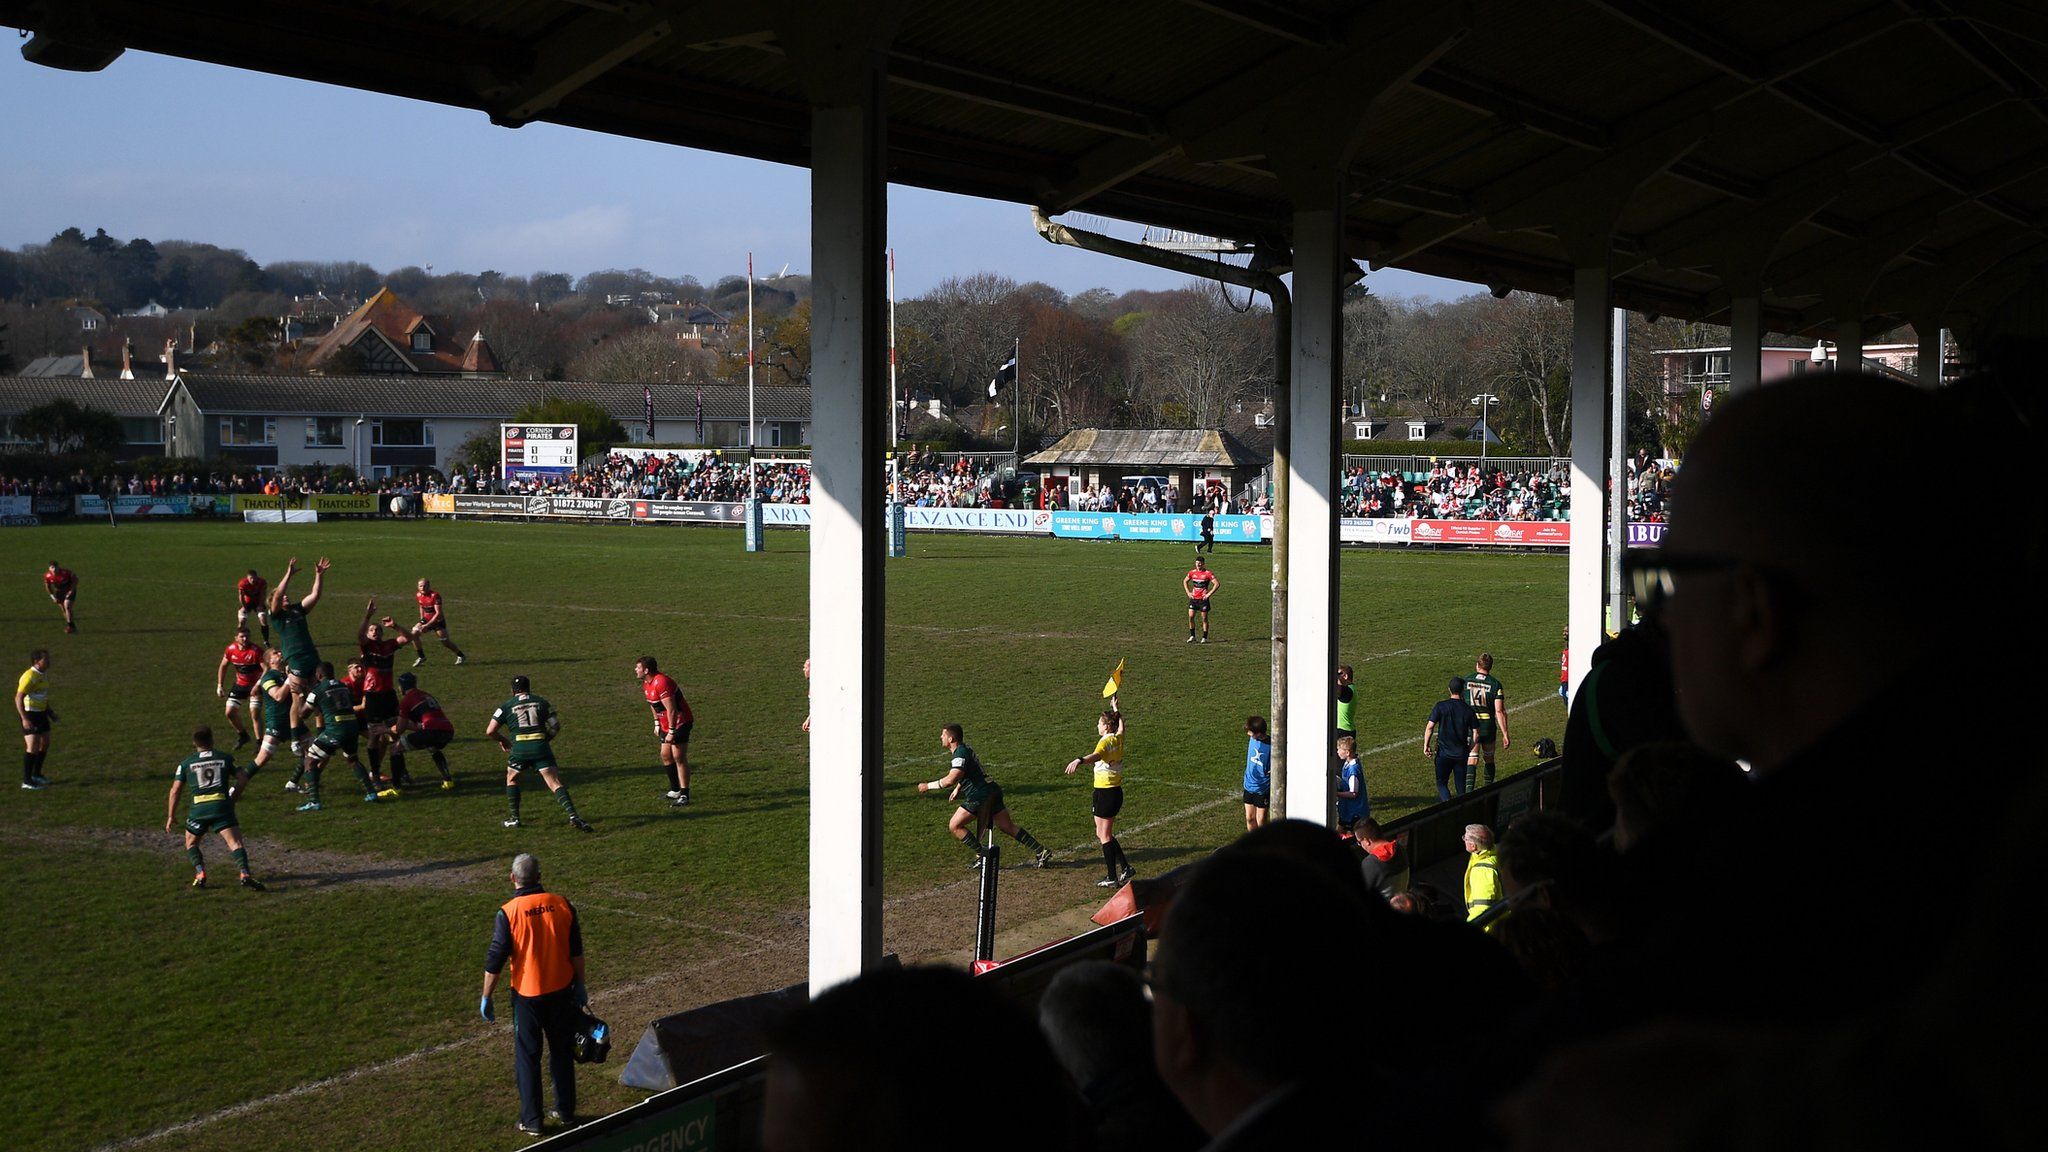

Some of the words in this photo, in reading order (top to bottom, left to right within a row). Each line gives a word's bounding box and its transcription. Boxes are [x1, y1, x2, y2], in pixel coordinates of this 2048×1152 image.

[243, 498, 300, 509] THATCHERS
[317, 498, 371, 509] THATCHERS
[553, 499, 575, 508] 01872
[576, 500, 603, 509] 270847
[904, 510, 989, 527] ENZANCE
[994, 512, 1028, 528] END
[1082, 517, 1099, 525] KING
[1101, 517, 1116, 526] IPA
[1170, 518, 1185, 529] IPA
[1220, 520, 1239, 528] KING
[1242, 520, 1257, 530] IPA
[1387, 523, 1411, 535] fwb
[204, 768, 215, 787] 9
[524, 903, 556, 918] MEDIC
[620, 1115, 709, 1152] GENCY
